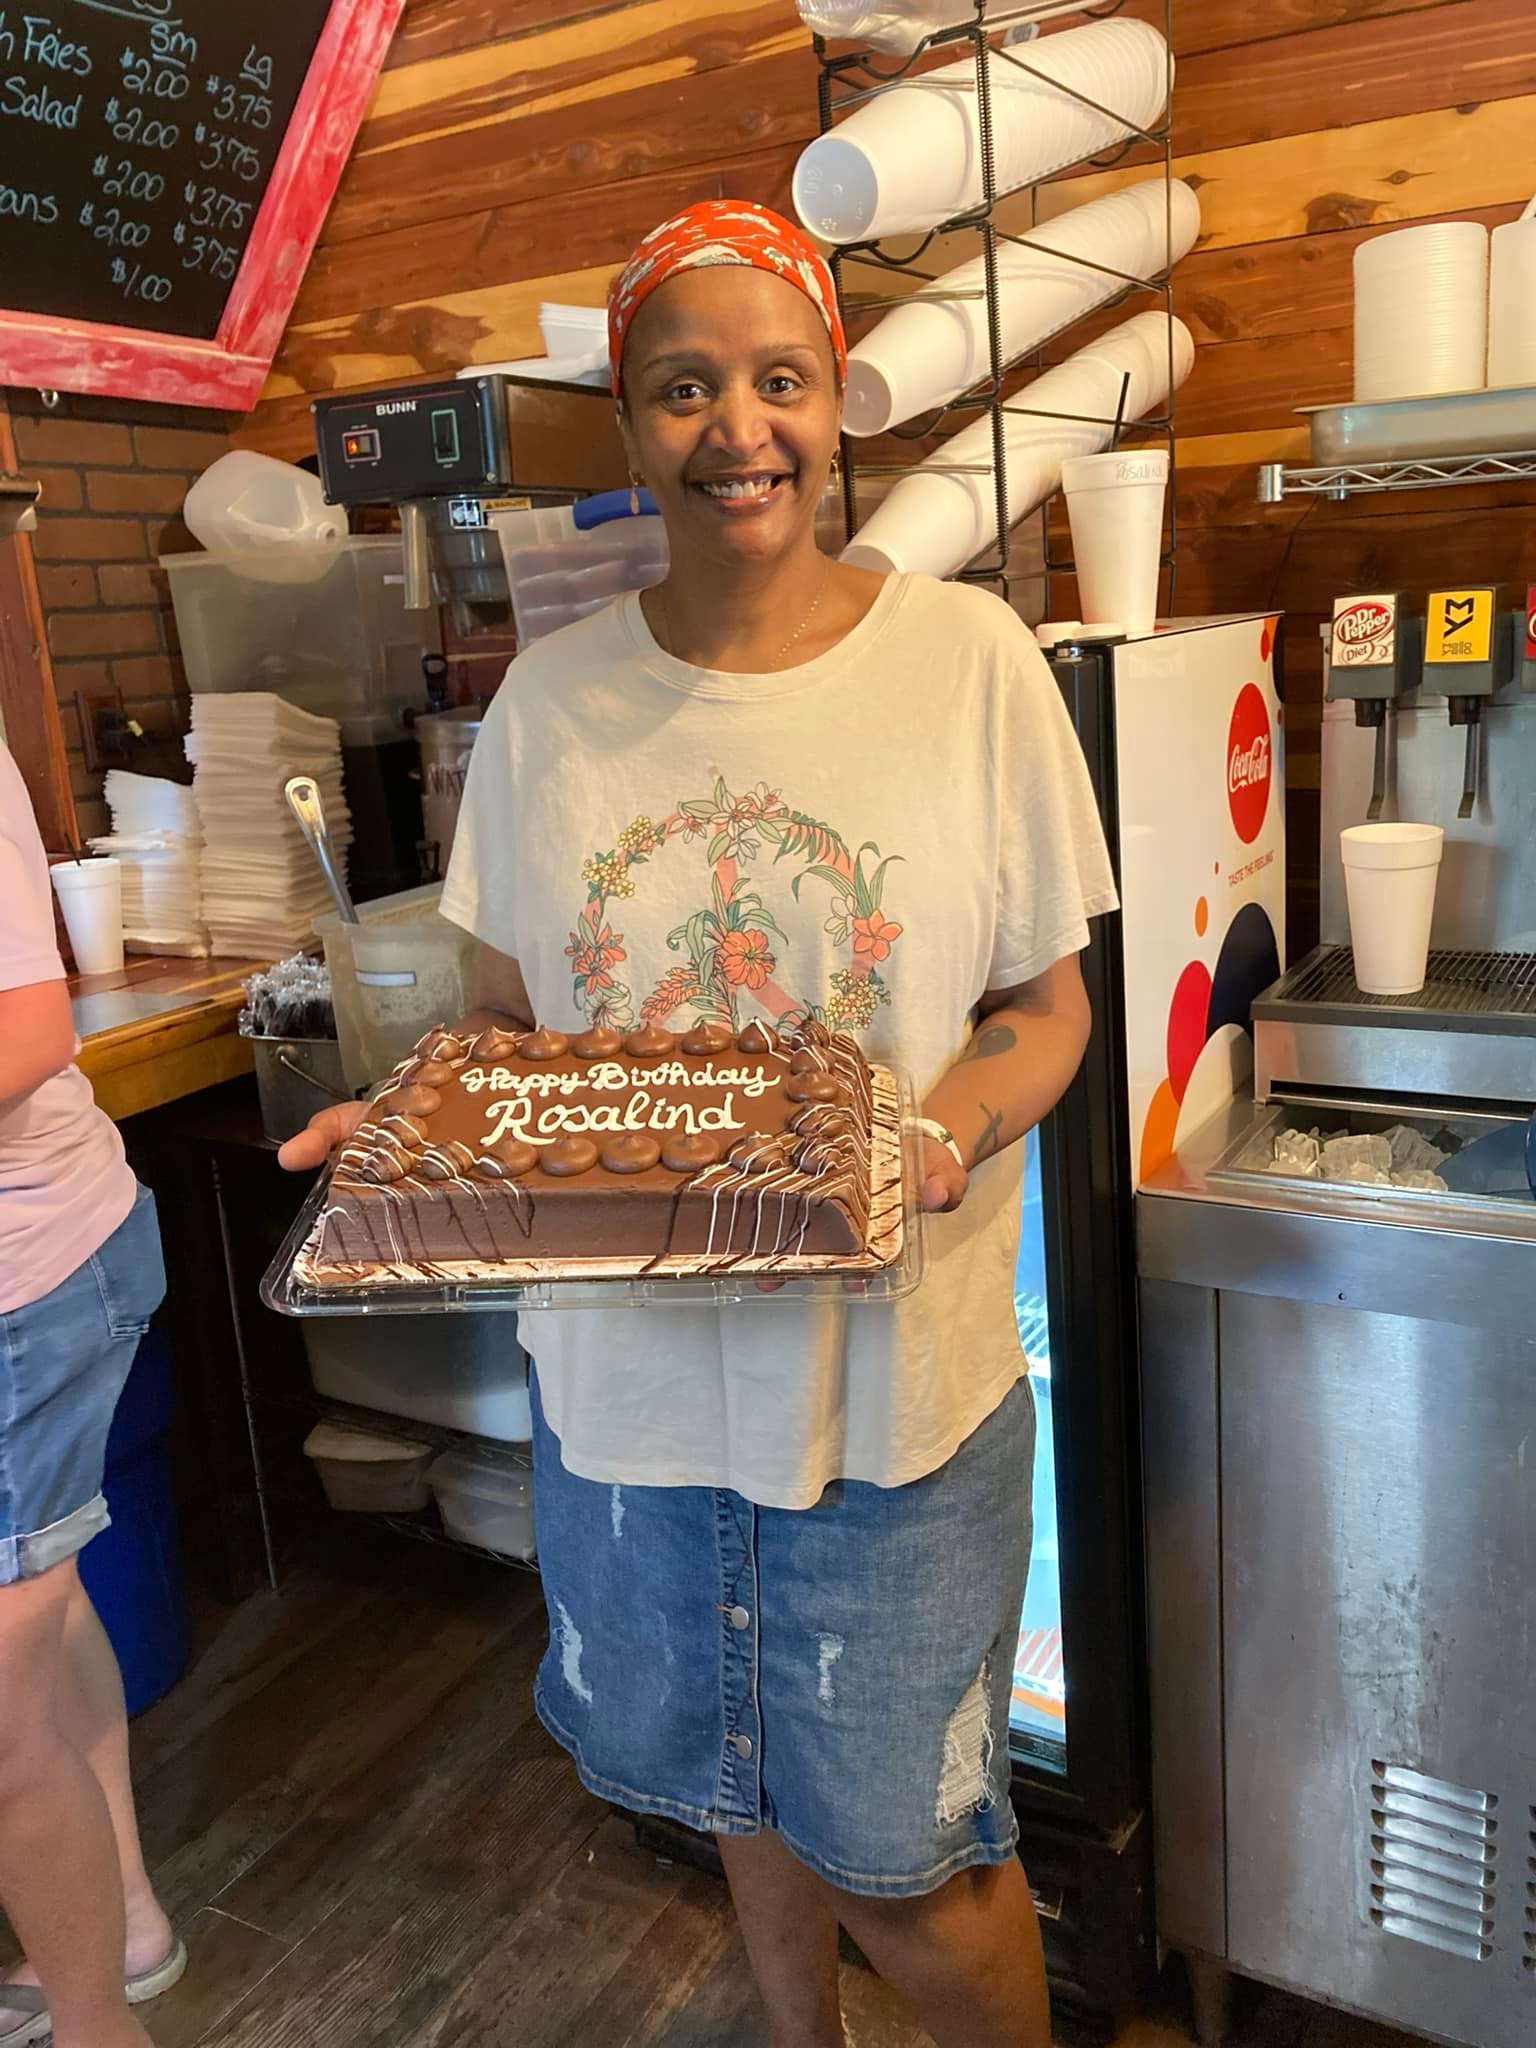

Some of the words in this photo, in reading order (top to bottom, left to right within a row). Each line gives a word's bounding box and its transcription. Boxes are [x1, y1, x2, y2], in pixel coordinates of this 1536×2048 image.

[0, 75, 83, 129] Salad
[0, 184, 59, 223] ans
[375, 401, 417, 416] BUNN
[1343, 611, 1390, 642] Pepper
[1356, 607, 1377, 624] Dr
[1346, 645, 1368, 661] Diet
[459, 1067, 588, 1096] Happy
[586, 1062, 781, 1097] Birthday
[479, 1091, 747, 1147] Rosalind
